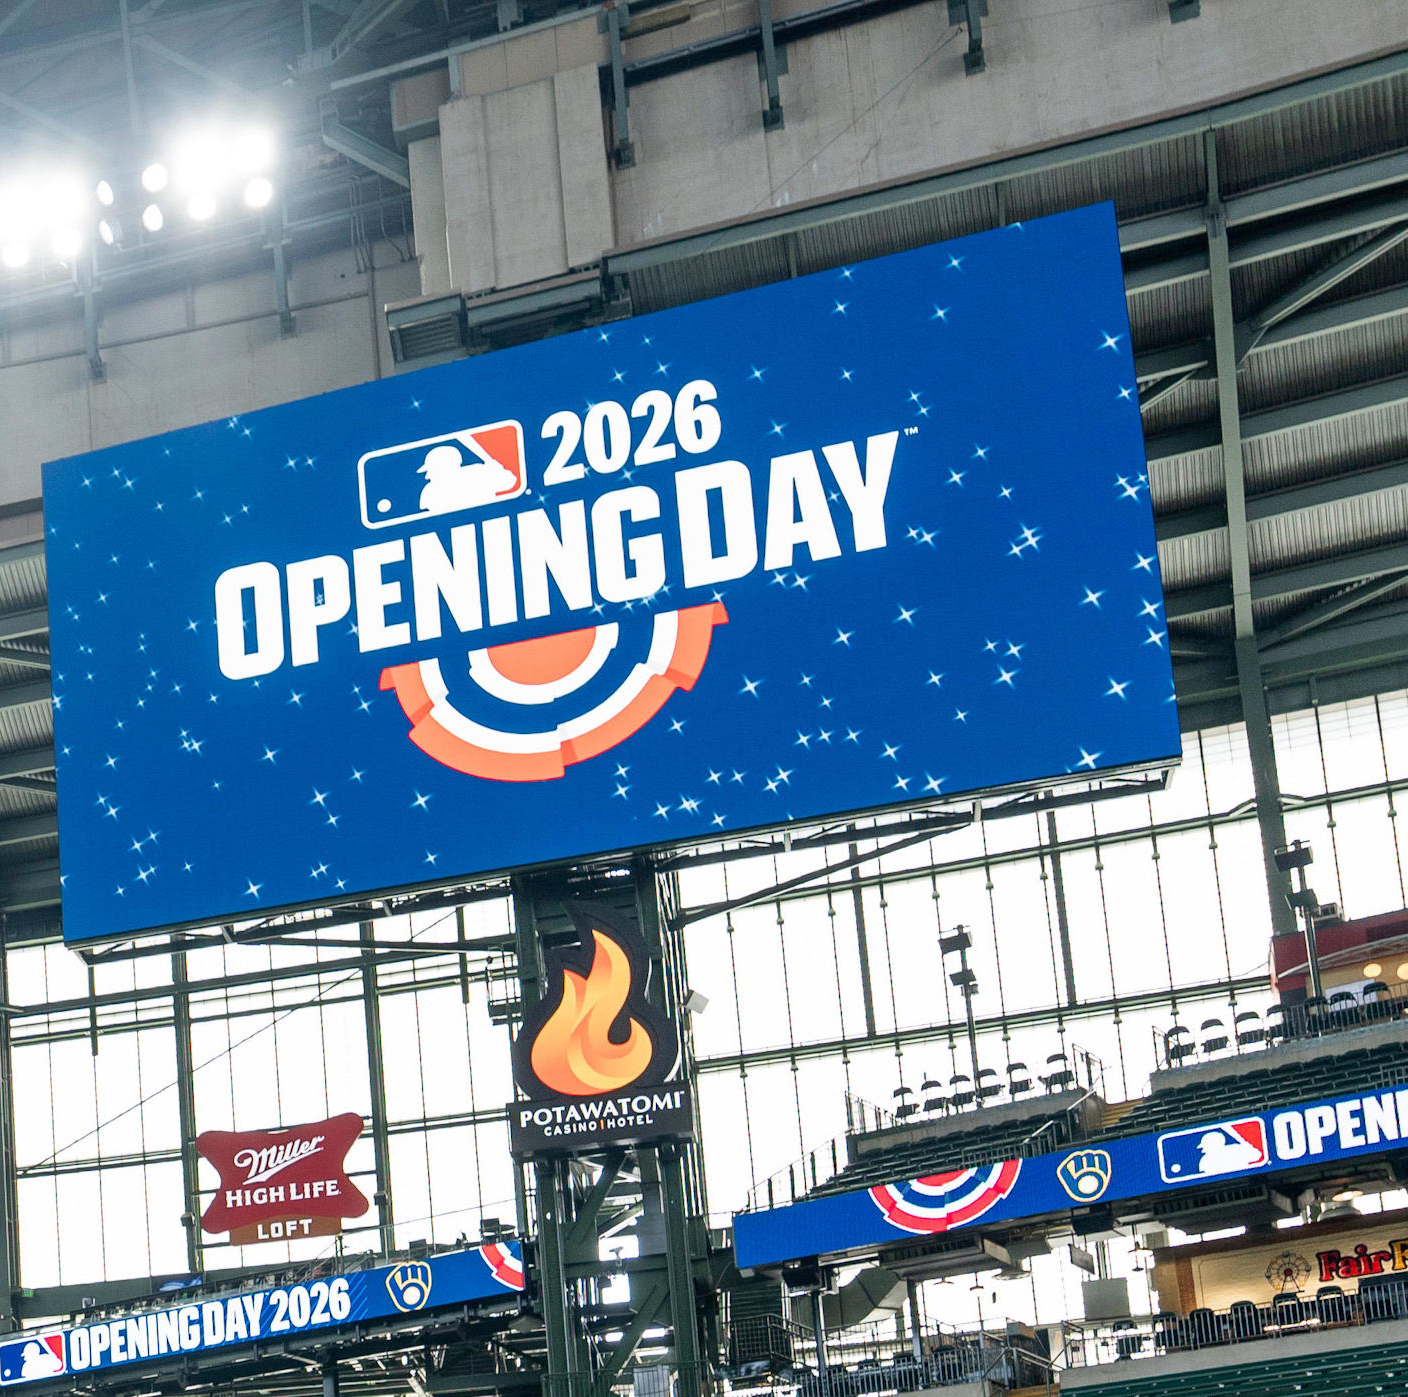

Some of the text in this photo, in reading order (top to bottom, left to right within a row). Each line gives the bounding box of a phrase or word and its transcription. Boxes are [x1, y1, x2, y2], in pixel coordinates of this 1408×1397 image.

[541, 379, 722, 487] 2026
[214, 486, 668, 681] OPENING
[519, 1091, 683, 1128] POTAWATOMI
[543, 1113, 653, 1137] CASINO HOTEL
[233, 1136, 325, 1184] Miller
[225, 1179, 340, 1208] HIGH LIFE
[257, 1218, 313, 1240] LOFT
[1316, 1244, 1392, 1283] Fair
[70, 1276, 352, 1371] OPENING DAY 2026
